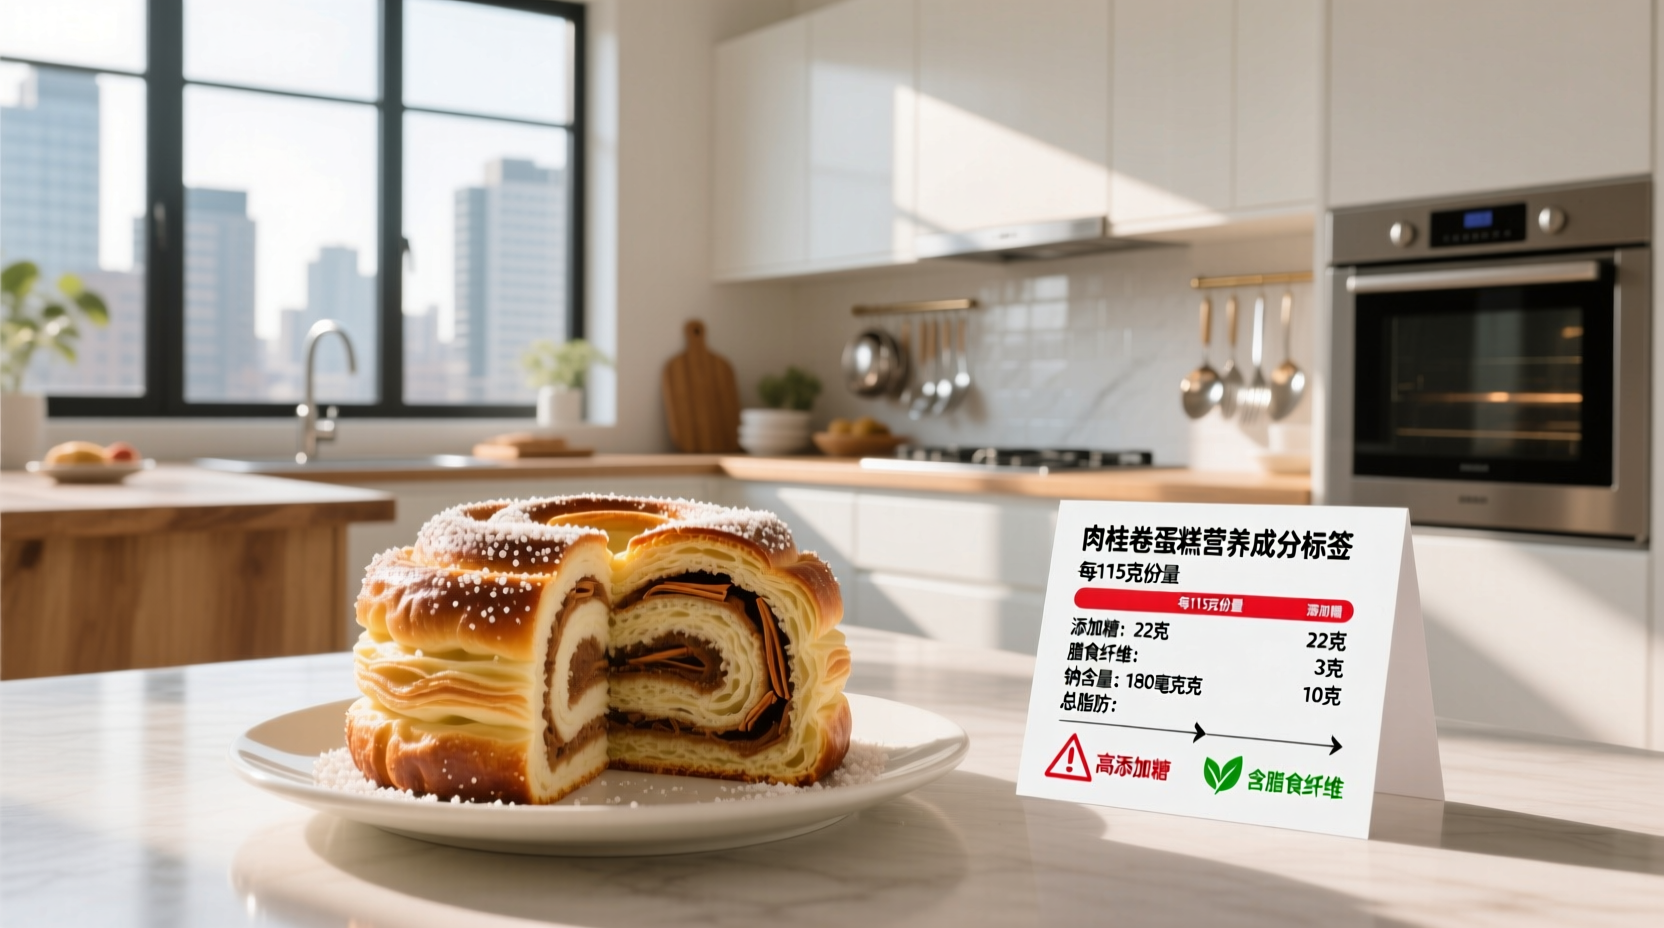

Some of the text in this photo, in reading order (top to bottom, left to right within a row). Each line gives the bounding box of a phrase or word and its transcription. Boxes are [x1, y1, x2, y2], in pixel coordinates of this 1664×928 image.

[1082, 523, 1355, 561] 肉桂卷蛋糕营养成分标签
[1077, 560, 1181, 585] 每115克份量
[1306, 630, 1348, 652] 22克
[1314, 657, 1345, 679] 3克
[1303, 684, 1342, 707] 10克
[1095, 752, 1172, 781] 高添加糖
